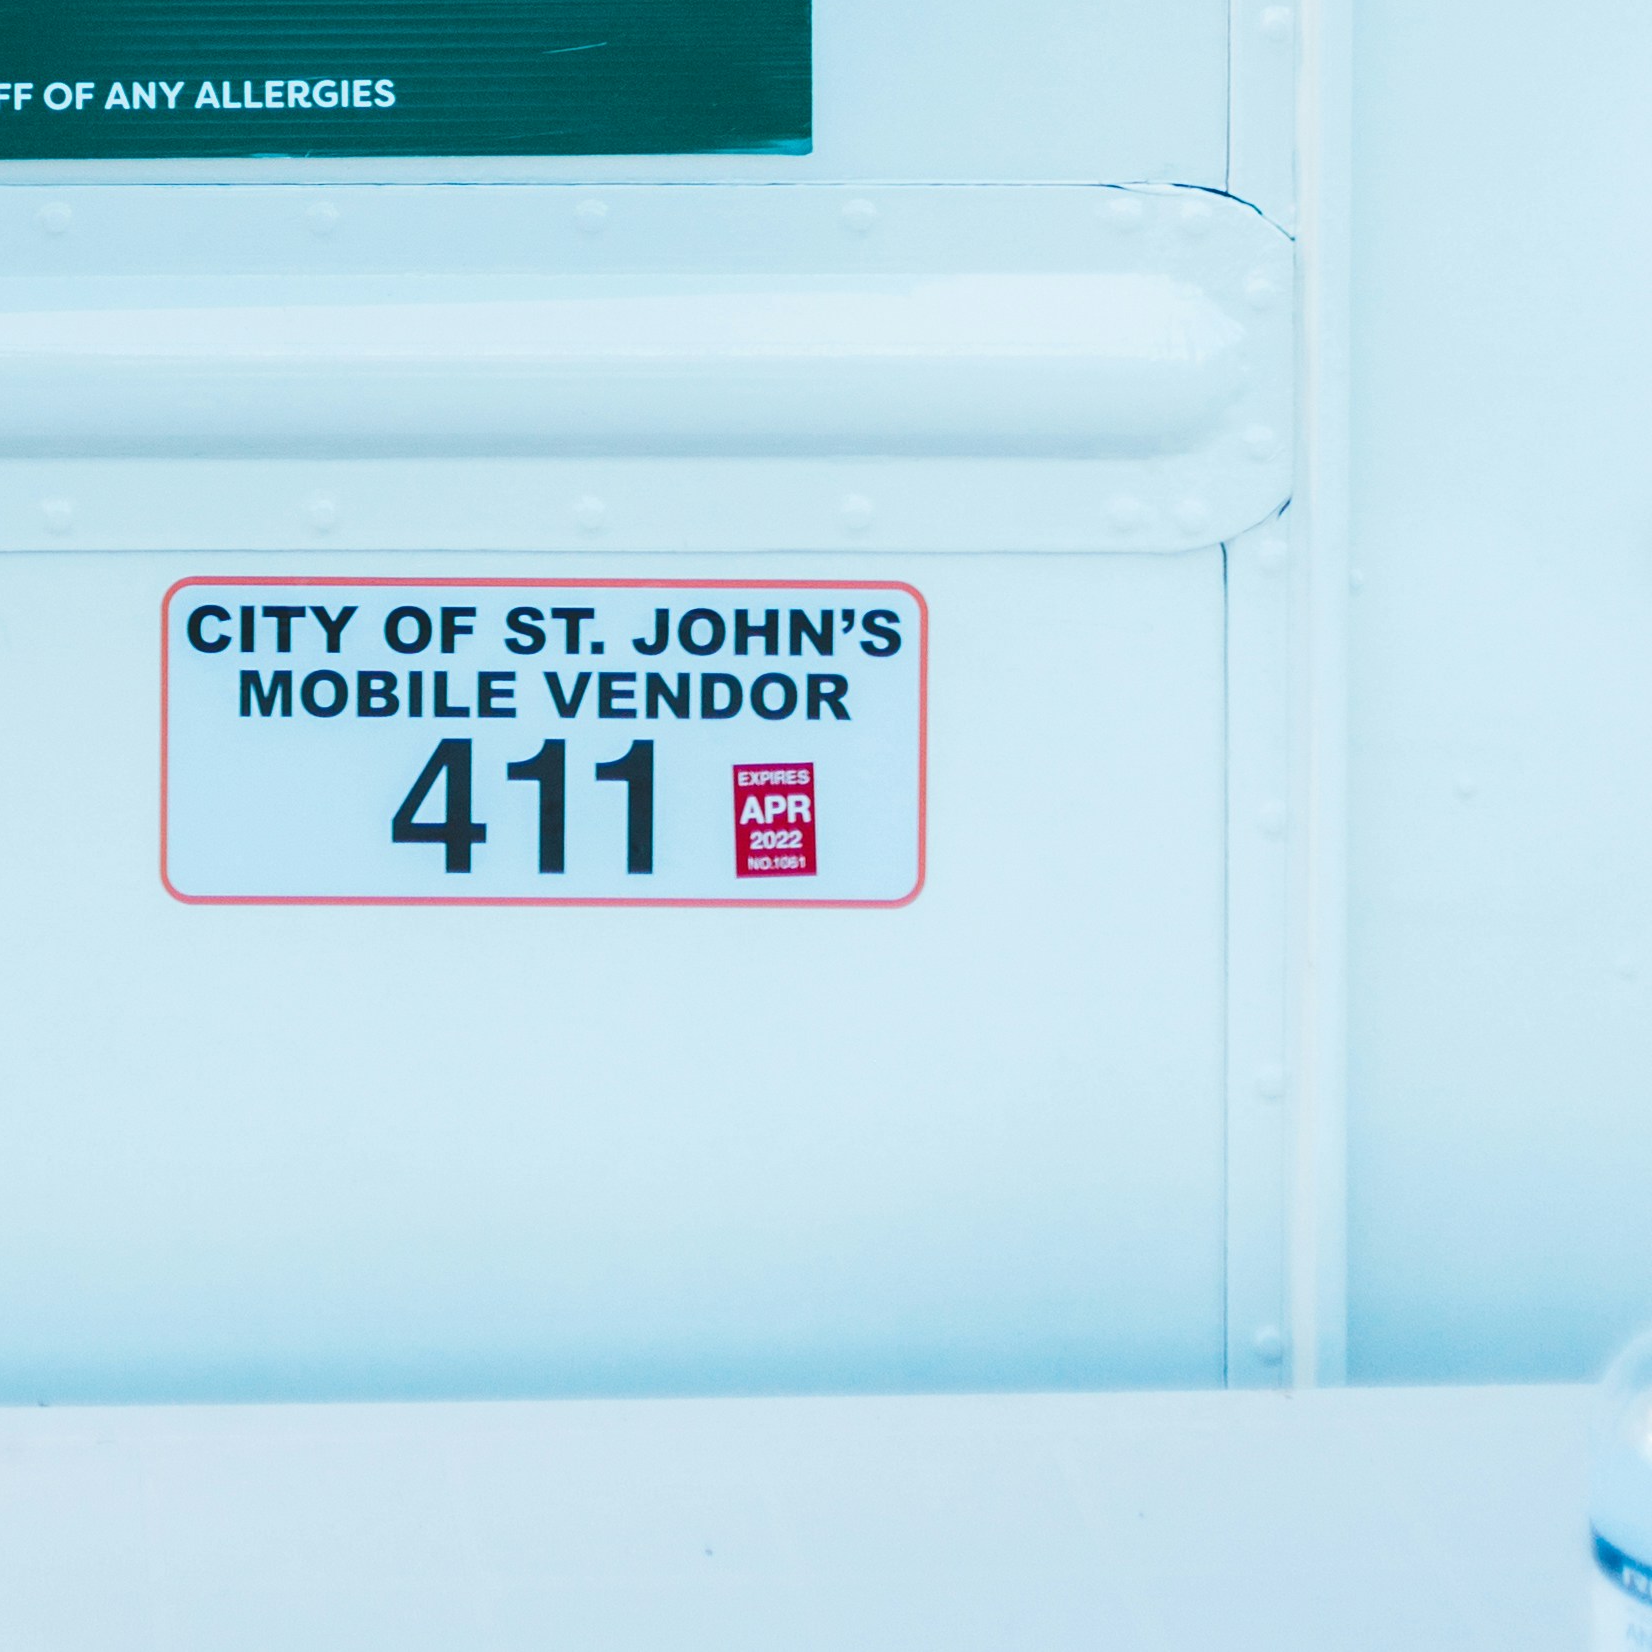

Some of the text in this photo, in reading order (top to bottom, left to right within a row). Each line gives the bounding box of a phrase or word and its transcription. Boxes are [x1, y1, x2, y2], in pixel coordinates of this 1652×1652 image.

[43, 82, 97, 112] OF
[105, 80, 186, 111] ANY
[195, 79, 397, 110] ALLERGIES
[186, 605, 904, 658] CITY OF ST. JOHN’S
[238, 669, 851, 721] MOBILE VENDOR
[738, 769, 810, 786] EXPIRES
[390, 738, 656, 876] 411
[740, 793, 812, 825] APR
[750, 830, 803, 850] 2022
